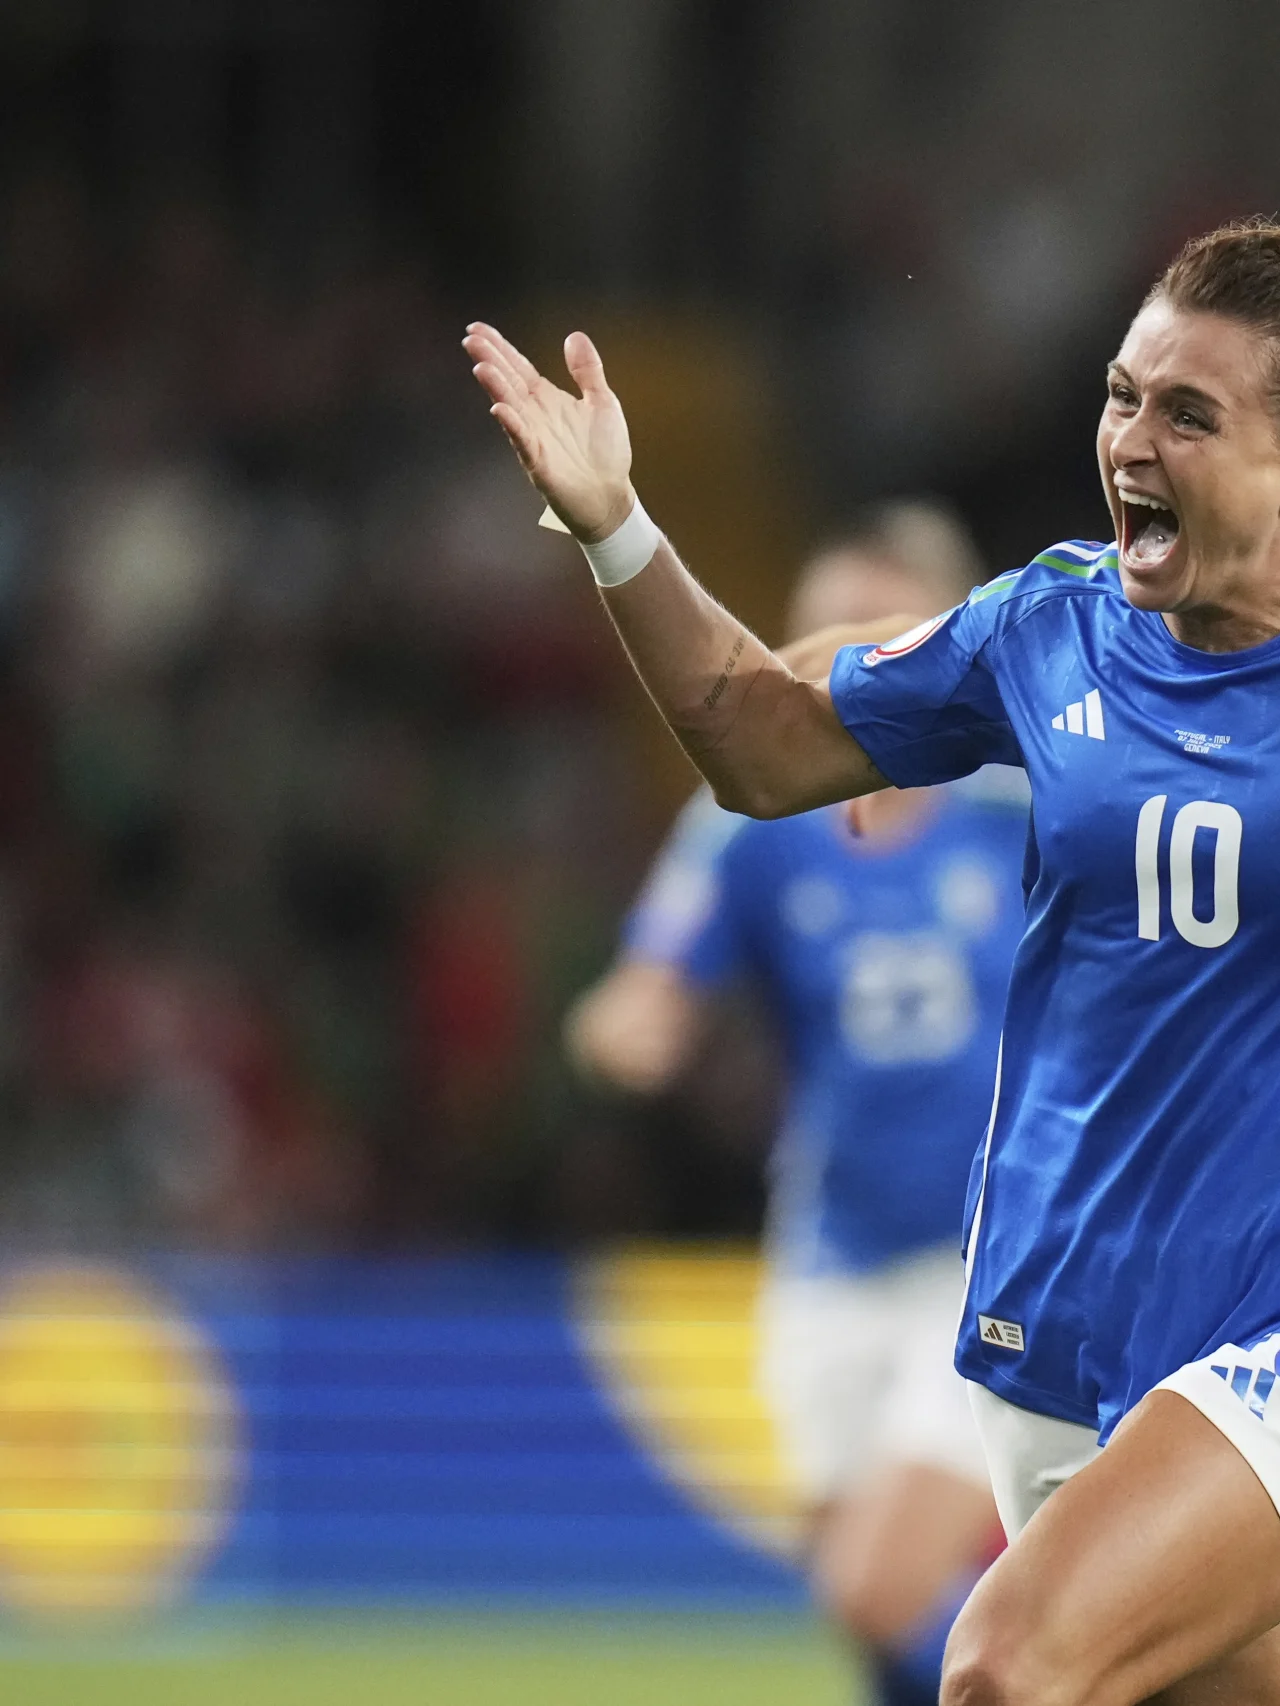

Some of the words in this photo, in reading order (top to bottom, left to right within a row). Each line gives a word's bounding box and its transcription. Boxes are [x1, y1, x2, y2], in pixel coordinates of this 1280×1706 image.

[1174, 729, 1206, 742] PORTUGAL
[1213, 735, 1231, 744] ITALY
[1183, 743, 1210, 754] GENEVA
[1135, 794, 1243, 948] 10
